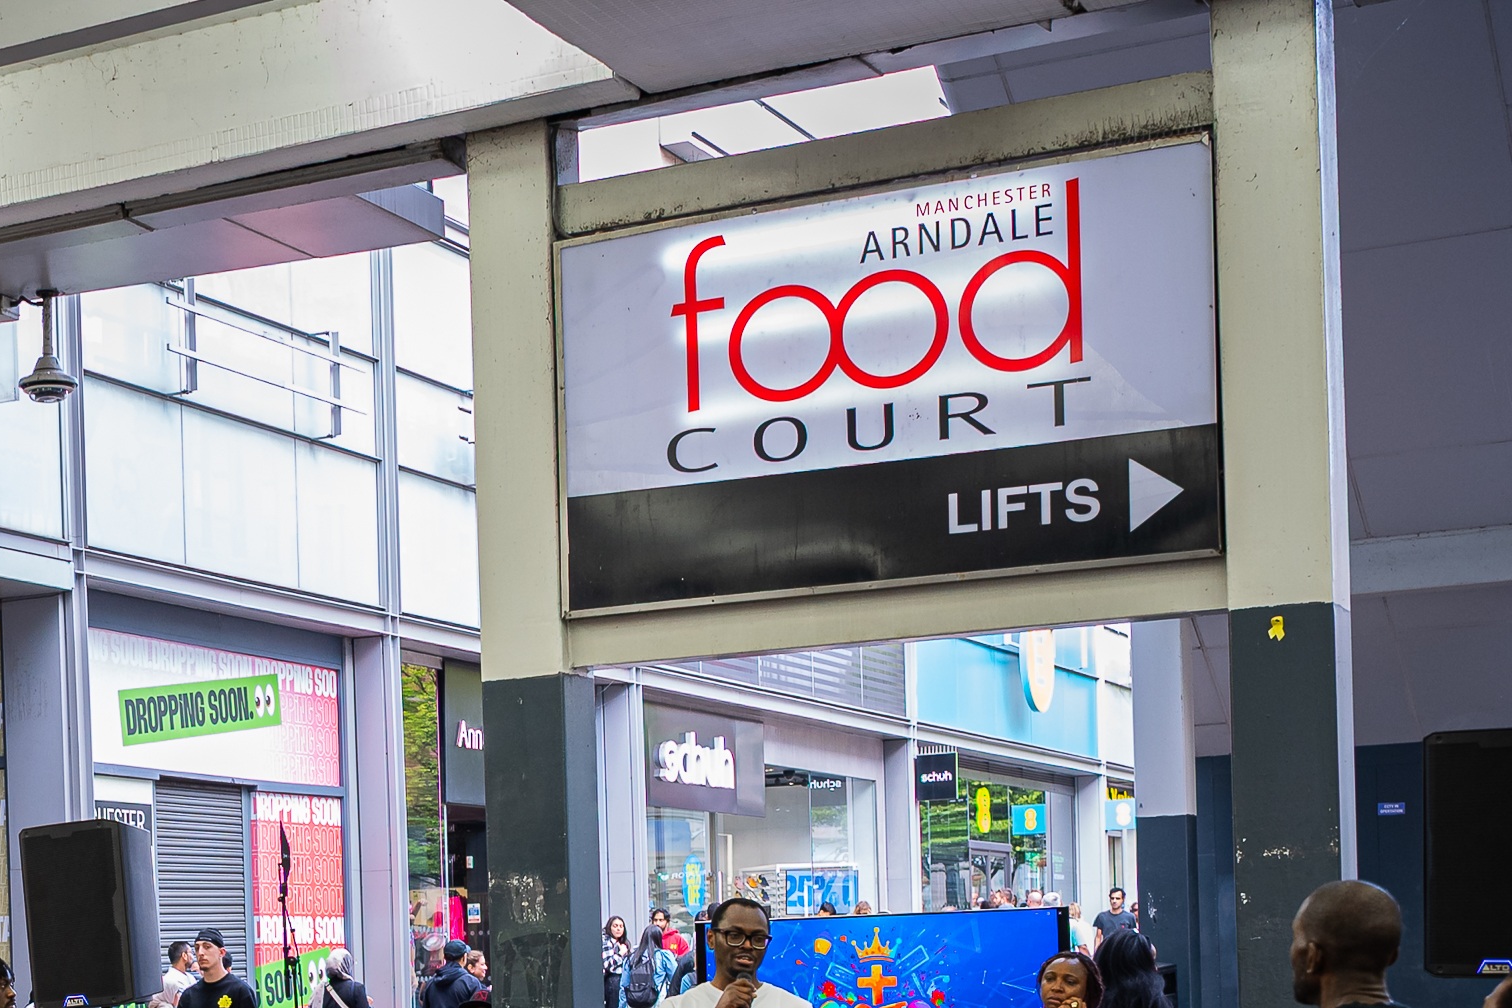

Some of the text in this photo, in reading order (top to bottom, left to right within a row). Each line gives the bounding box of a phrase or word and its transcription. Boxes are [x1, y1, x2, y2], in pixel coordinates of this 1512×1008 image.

[915, 181, 1052, 217] MANCHESTER
[859, 203, 1054, 264] ARNDALE
[670, 177, 1083, 413] food
[667, 376, 1091, 473] COURT
[948, 478, 1101, 534] LIFTS
[207, 687, 254, 726] SOON.
[655, 731, 736, 789] schuh
[920, 770, 953, 783] schuh
